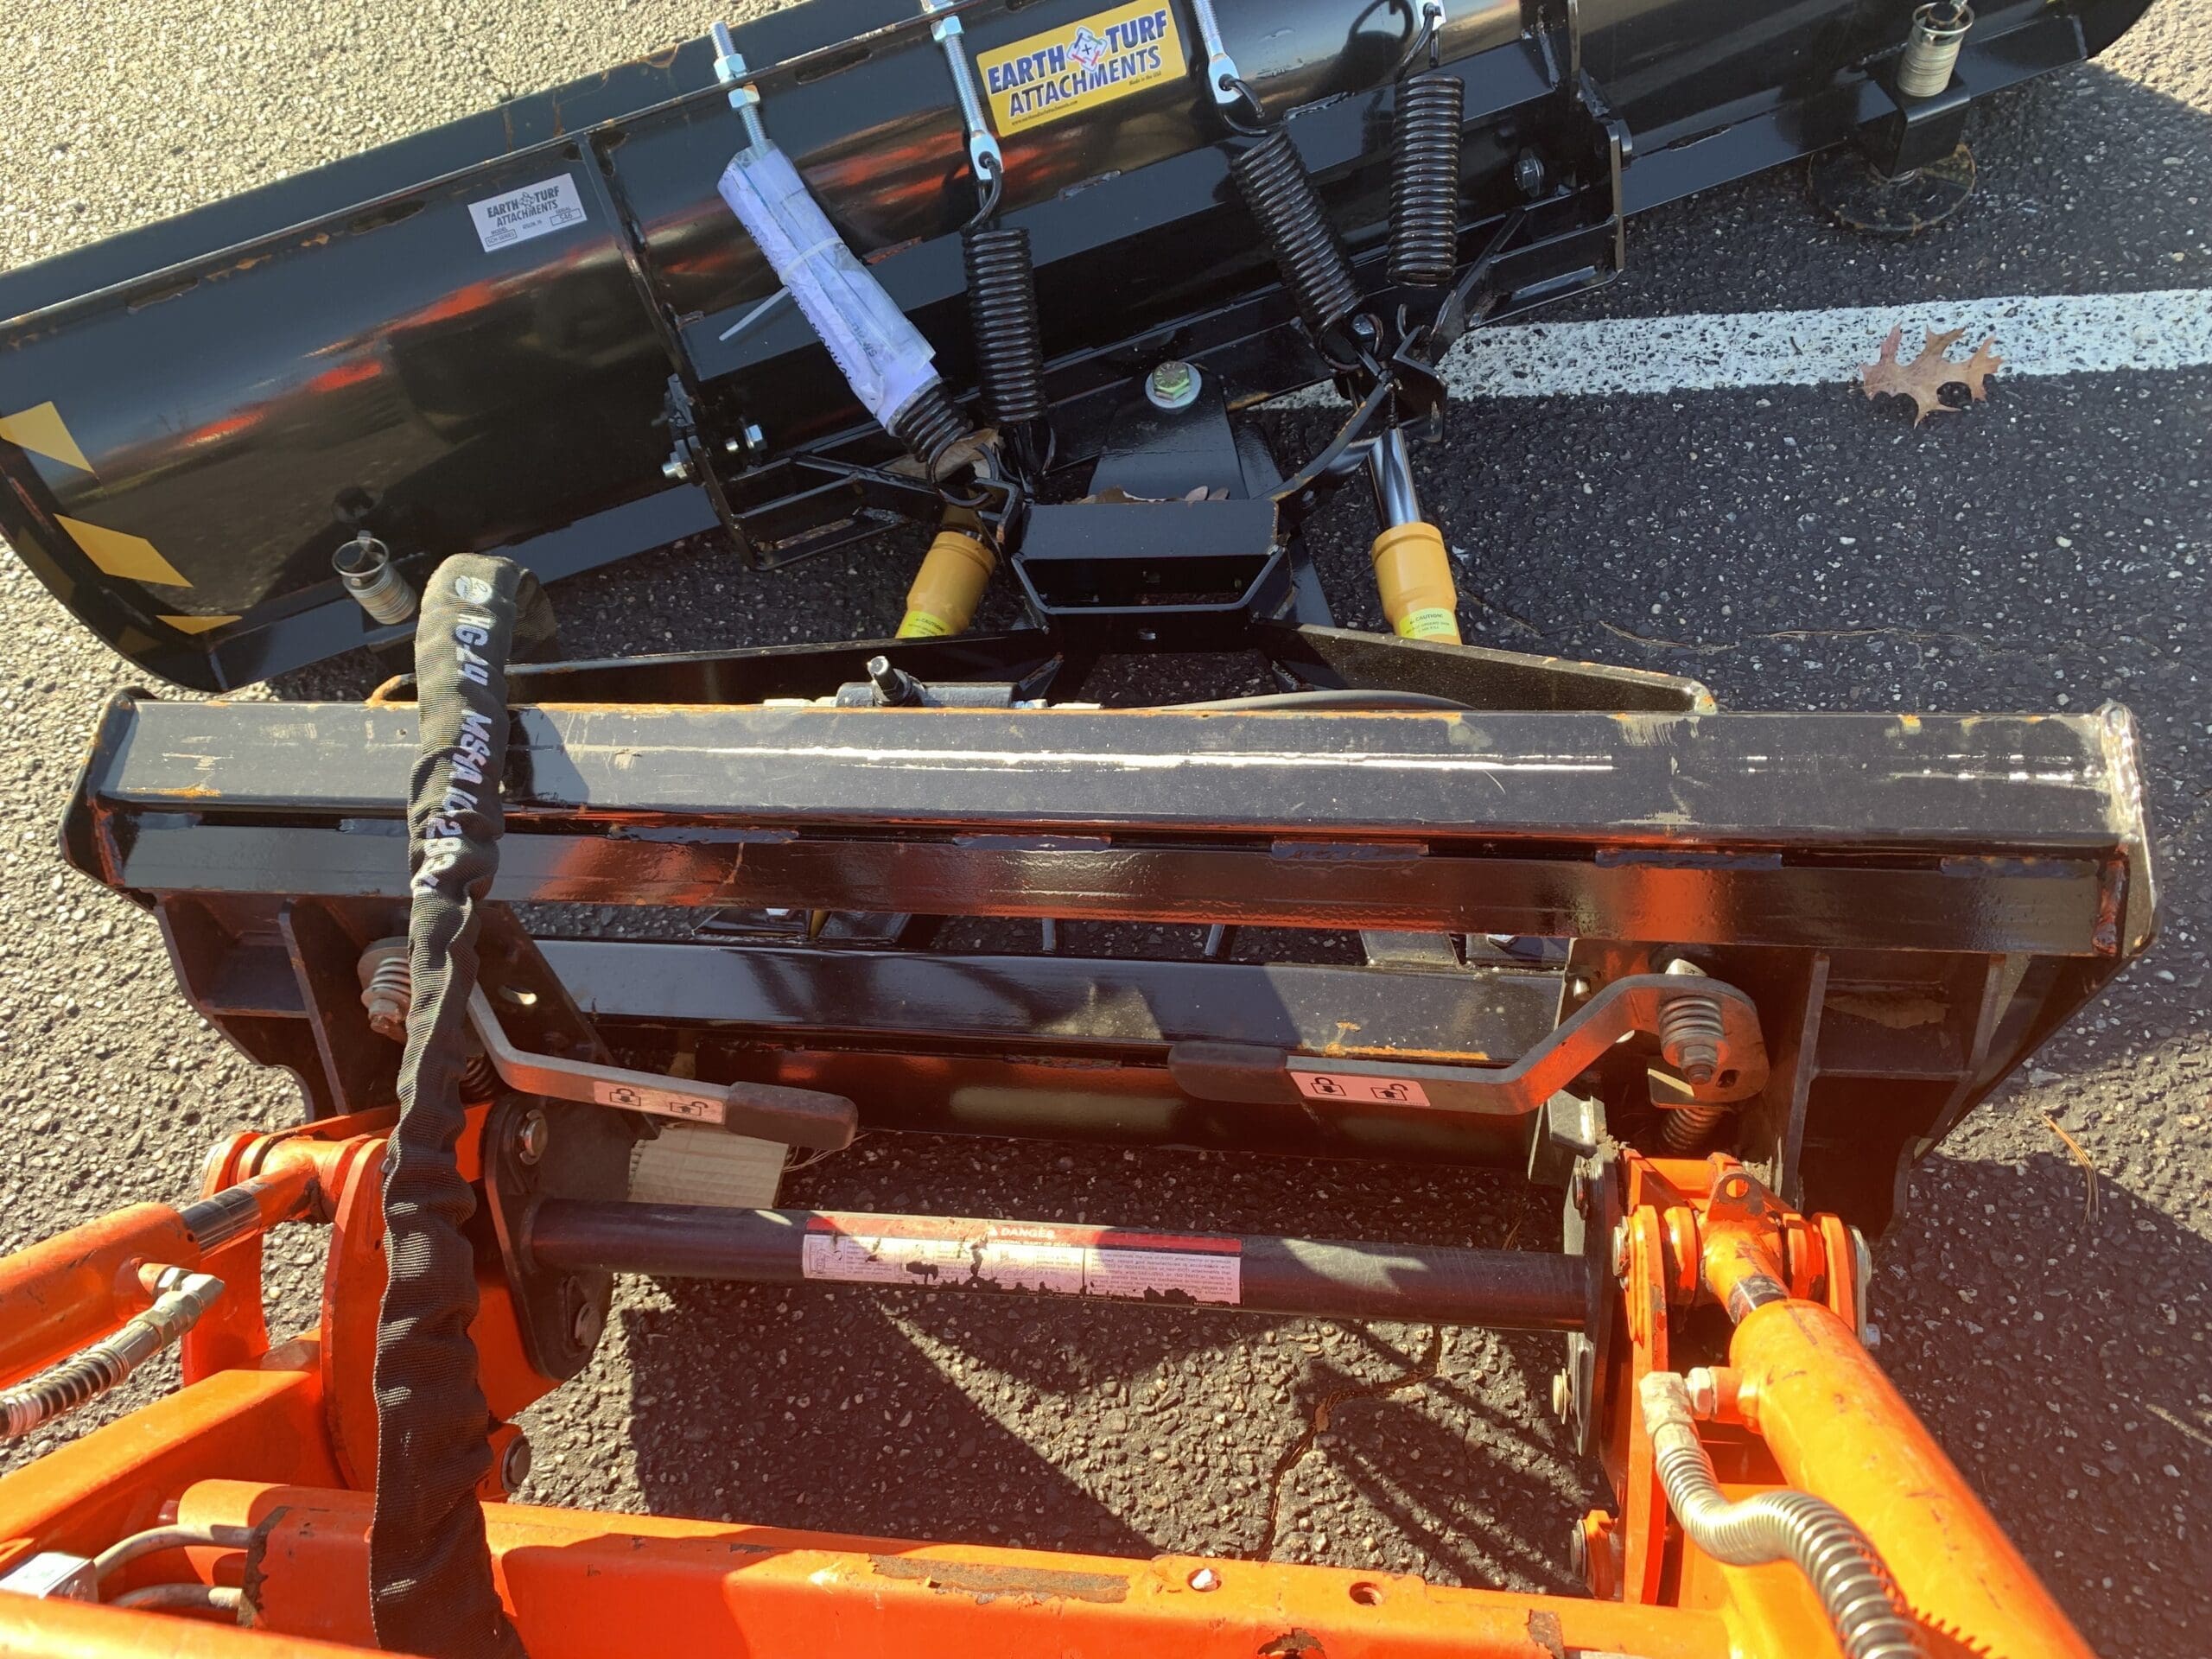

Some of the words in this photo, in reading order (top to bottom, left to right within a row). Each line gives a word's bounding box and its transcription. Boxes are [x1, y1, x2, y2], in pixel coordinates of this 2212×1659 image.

[987, 44, 1066, 95] EARTH
[1105, 10, 1167, 54] TURF
[1009, 45, 1161, 118] ATTACHMENTS
[486, 199, 520, 219] EARTH
[533, 186, 560, 203] TURF
[491, 226, 508, 235] MODEL
[497, 200, 558, 227] ATTACHMENTS
[454, 613, 490, 687] HG-24
[449, 709, 493, 785] MSHA
